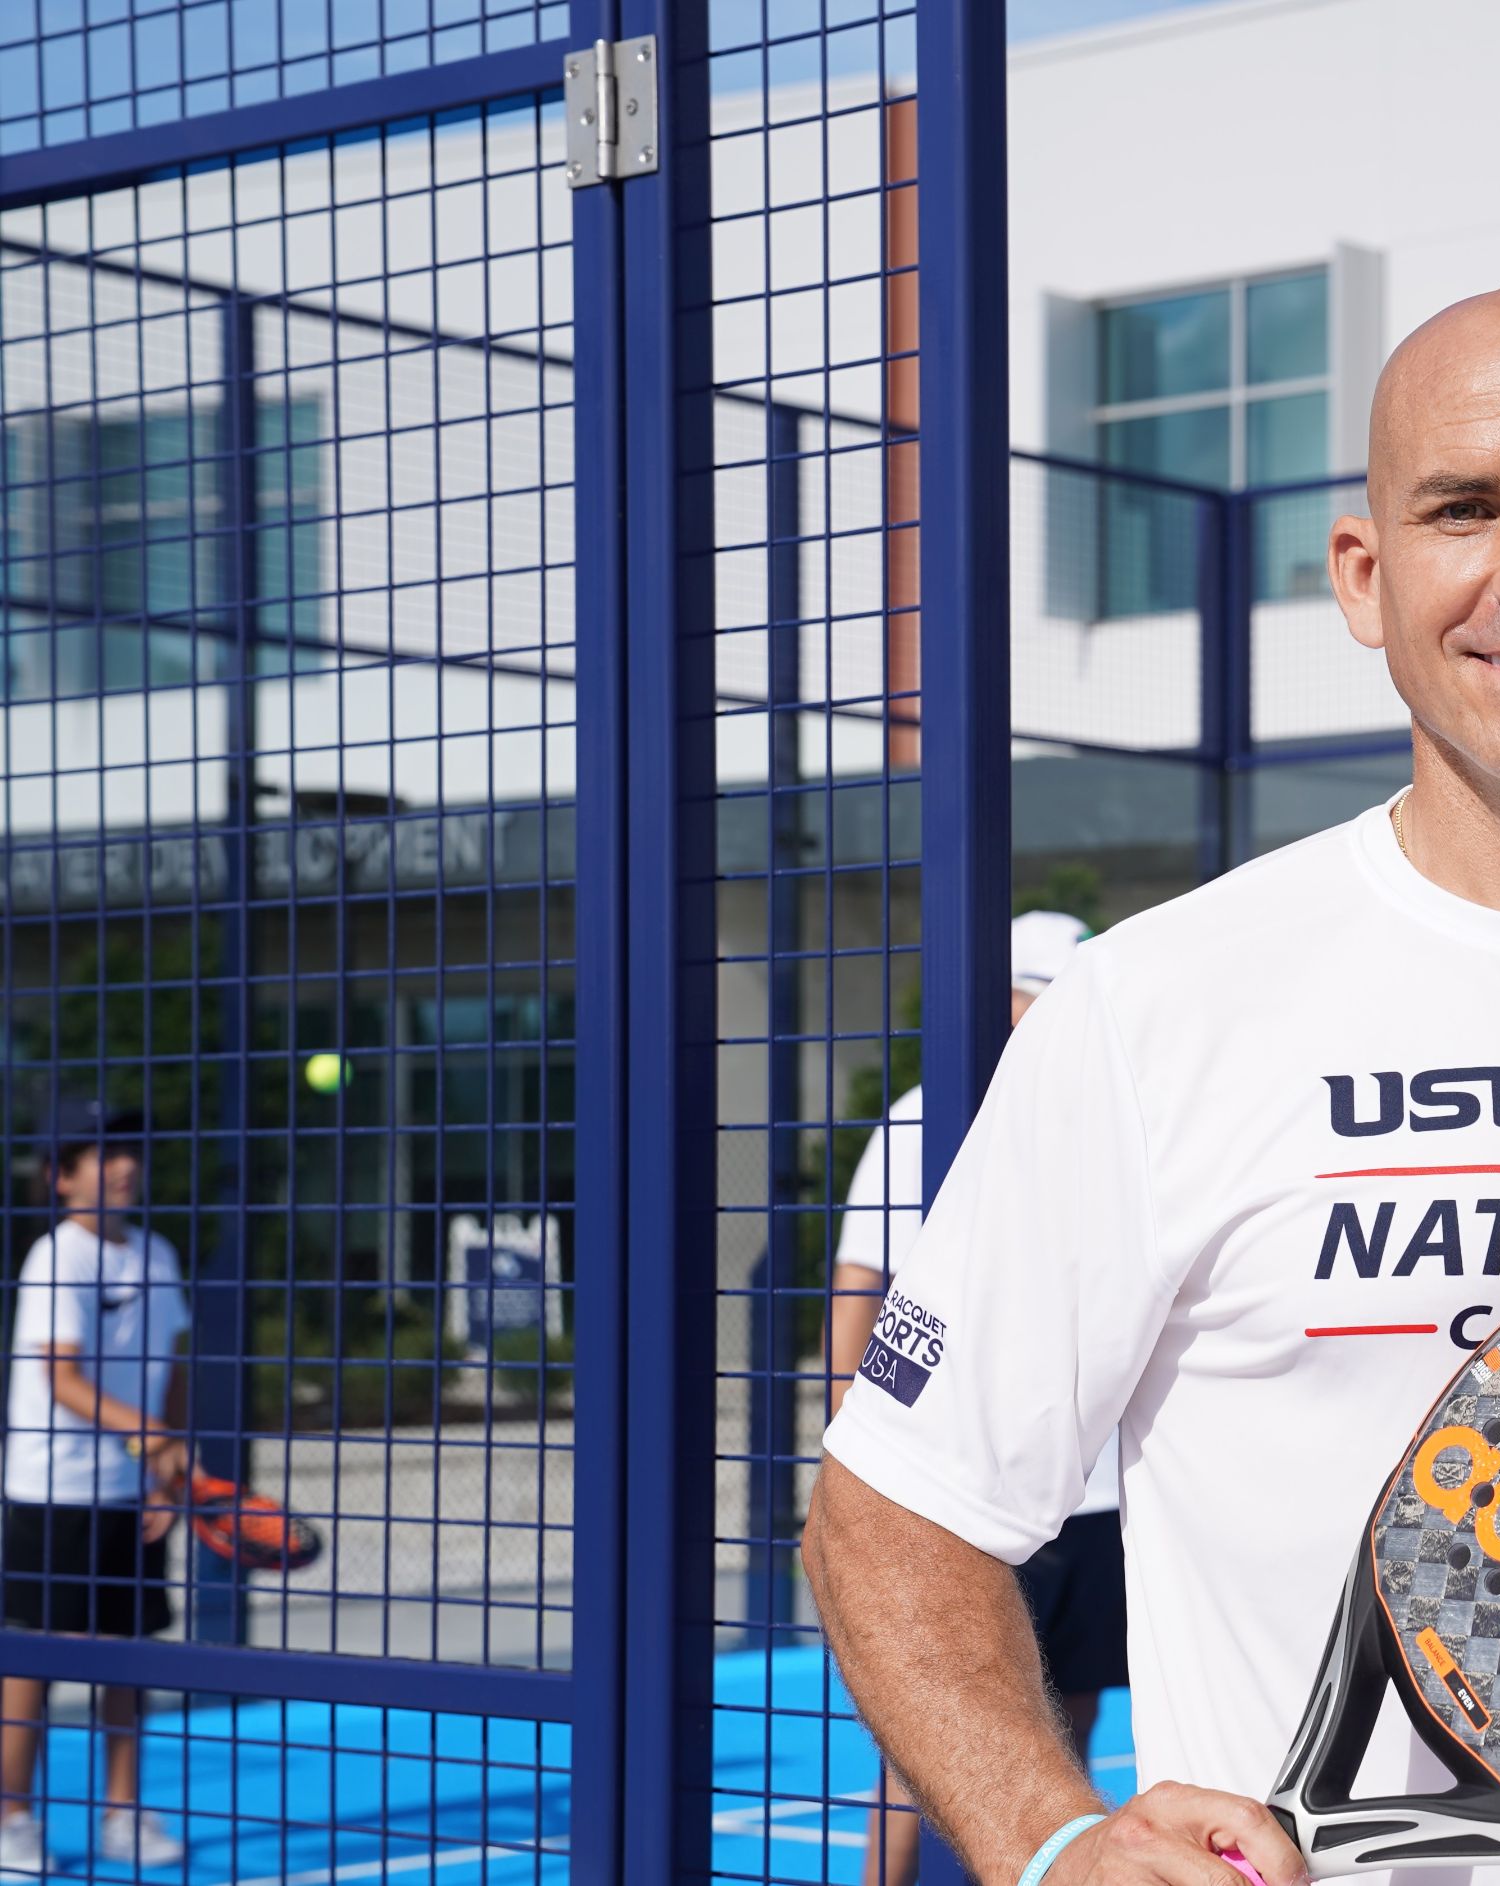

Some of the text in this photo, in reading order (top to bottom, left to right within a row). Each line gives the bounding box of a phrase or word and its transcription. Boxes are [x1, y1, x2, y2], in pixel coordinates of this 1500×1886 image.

[890, 1290, 947, 1338] RACQUET
[861, 1339, 898, 1389] USA
[1424, 1638, 1446, 1666] BALANCE
[1457, 1688, 1476, 1711] EVEN
